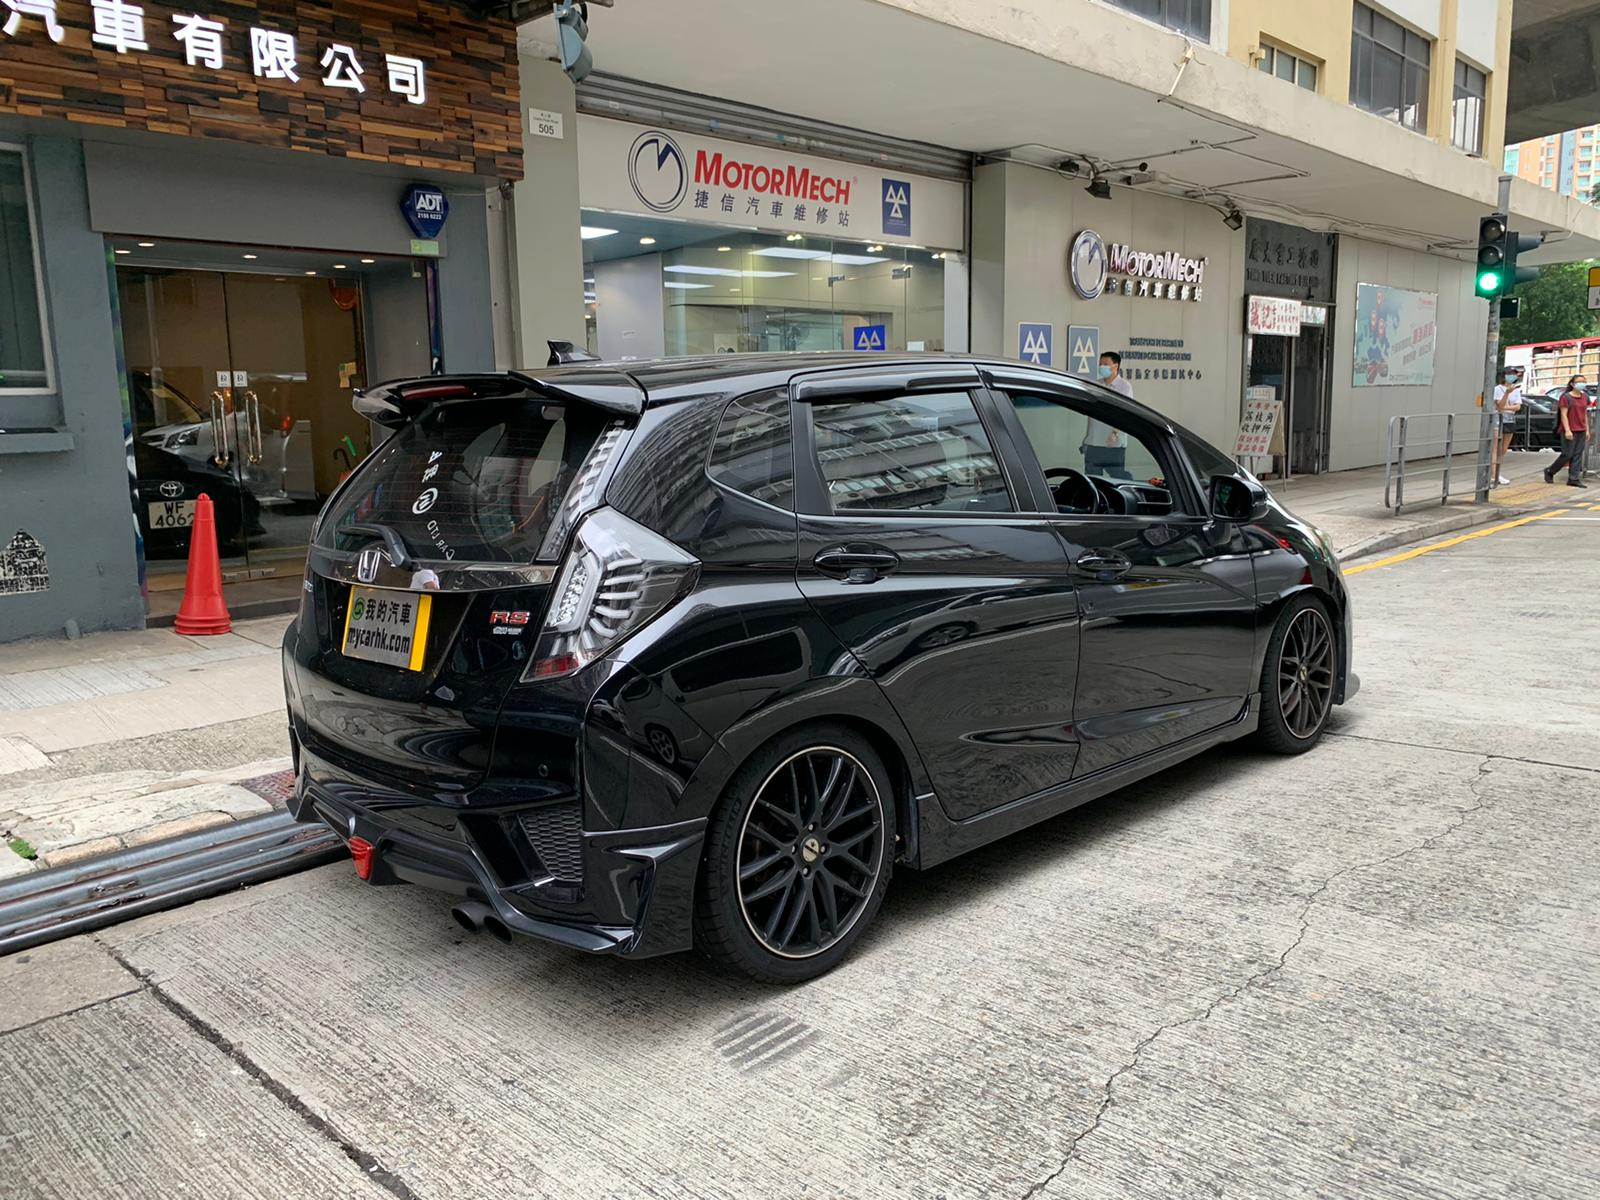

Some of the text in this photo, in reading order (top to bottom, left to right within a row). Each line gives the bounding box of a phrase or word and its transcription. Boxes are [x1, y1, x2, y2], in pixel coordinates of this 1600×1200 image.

[2, 0, 427, 104] 汽車有限公司
[539, 123, 554, 135] 505
[416, 194, 442, 212] ADT
[694, 189, 849, 227] 捷信汽車維修站
[164, 502, 185, 515] WF
[365, 598, 412, 626] 我的汽車
[490, 611, 530, 624] RS
[347, 627, 411, 654] mycarhk.com
